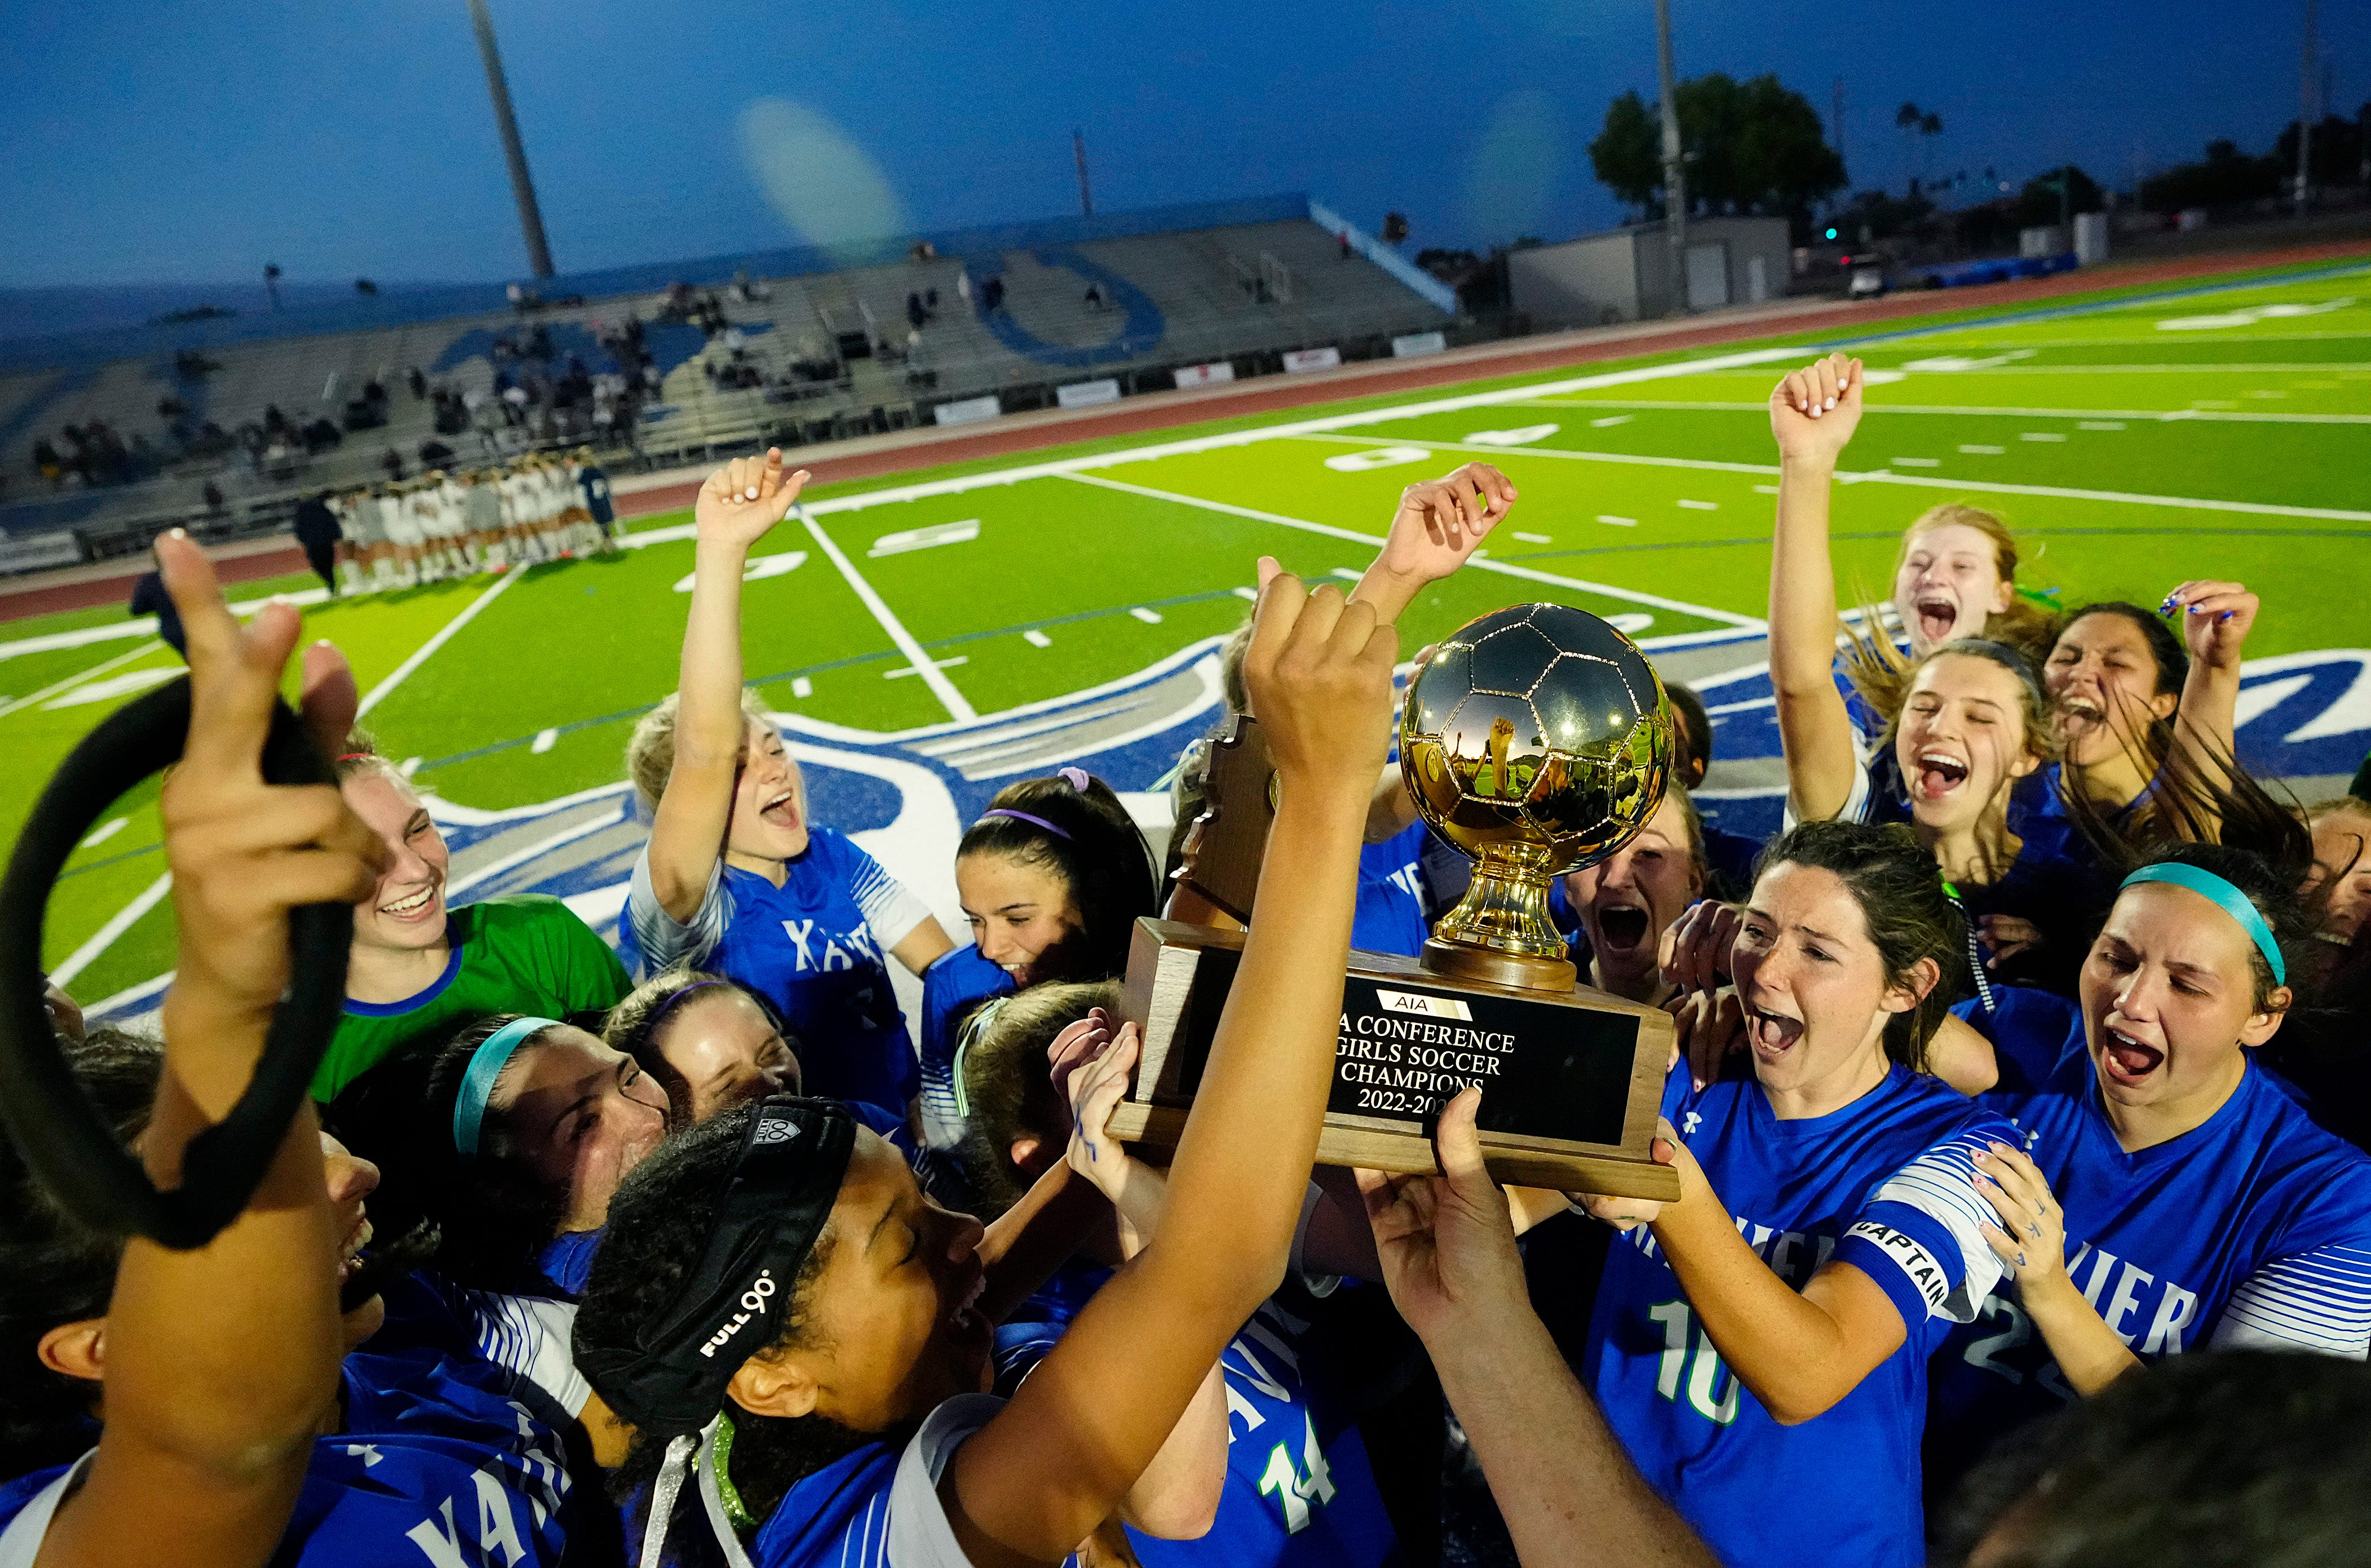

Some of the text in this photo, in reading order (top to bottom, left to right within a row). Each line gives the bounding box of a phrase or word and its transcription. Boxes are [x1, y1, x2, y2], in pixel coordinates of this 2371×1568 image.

[1395, 996, 1428, 1012] AIA
[1357, 1015, 1515, 1053] CONFERENCE
[1335, 1036, 1501, 1076] GIRLS SOCCER
[1341, 1061, 1484, 1095] CHAMPIONS
[1357, 1088, 1449, 1116] 2022-202
[757, 1120, 791, 1142] FULL 90
[1856, 1221, 1945, 1307] CAPTAIN
[1647, 1297, 1741, 1427] 10
[1257, 1405, 1338, 1537] 14
